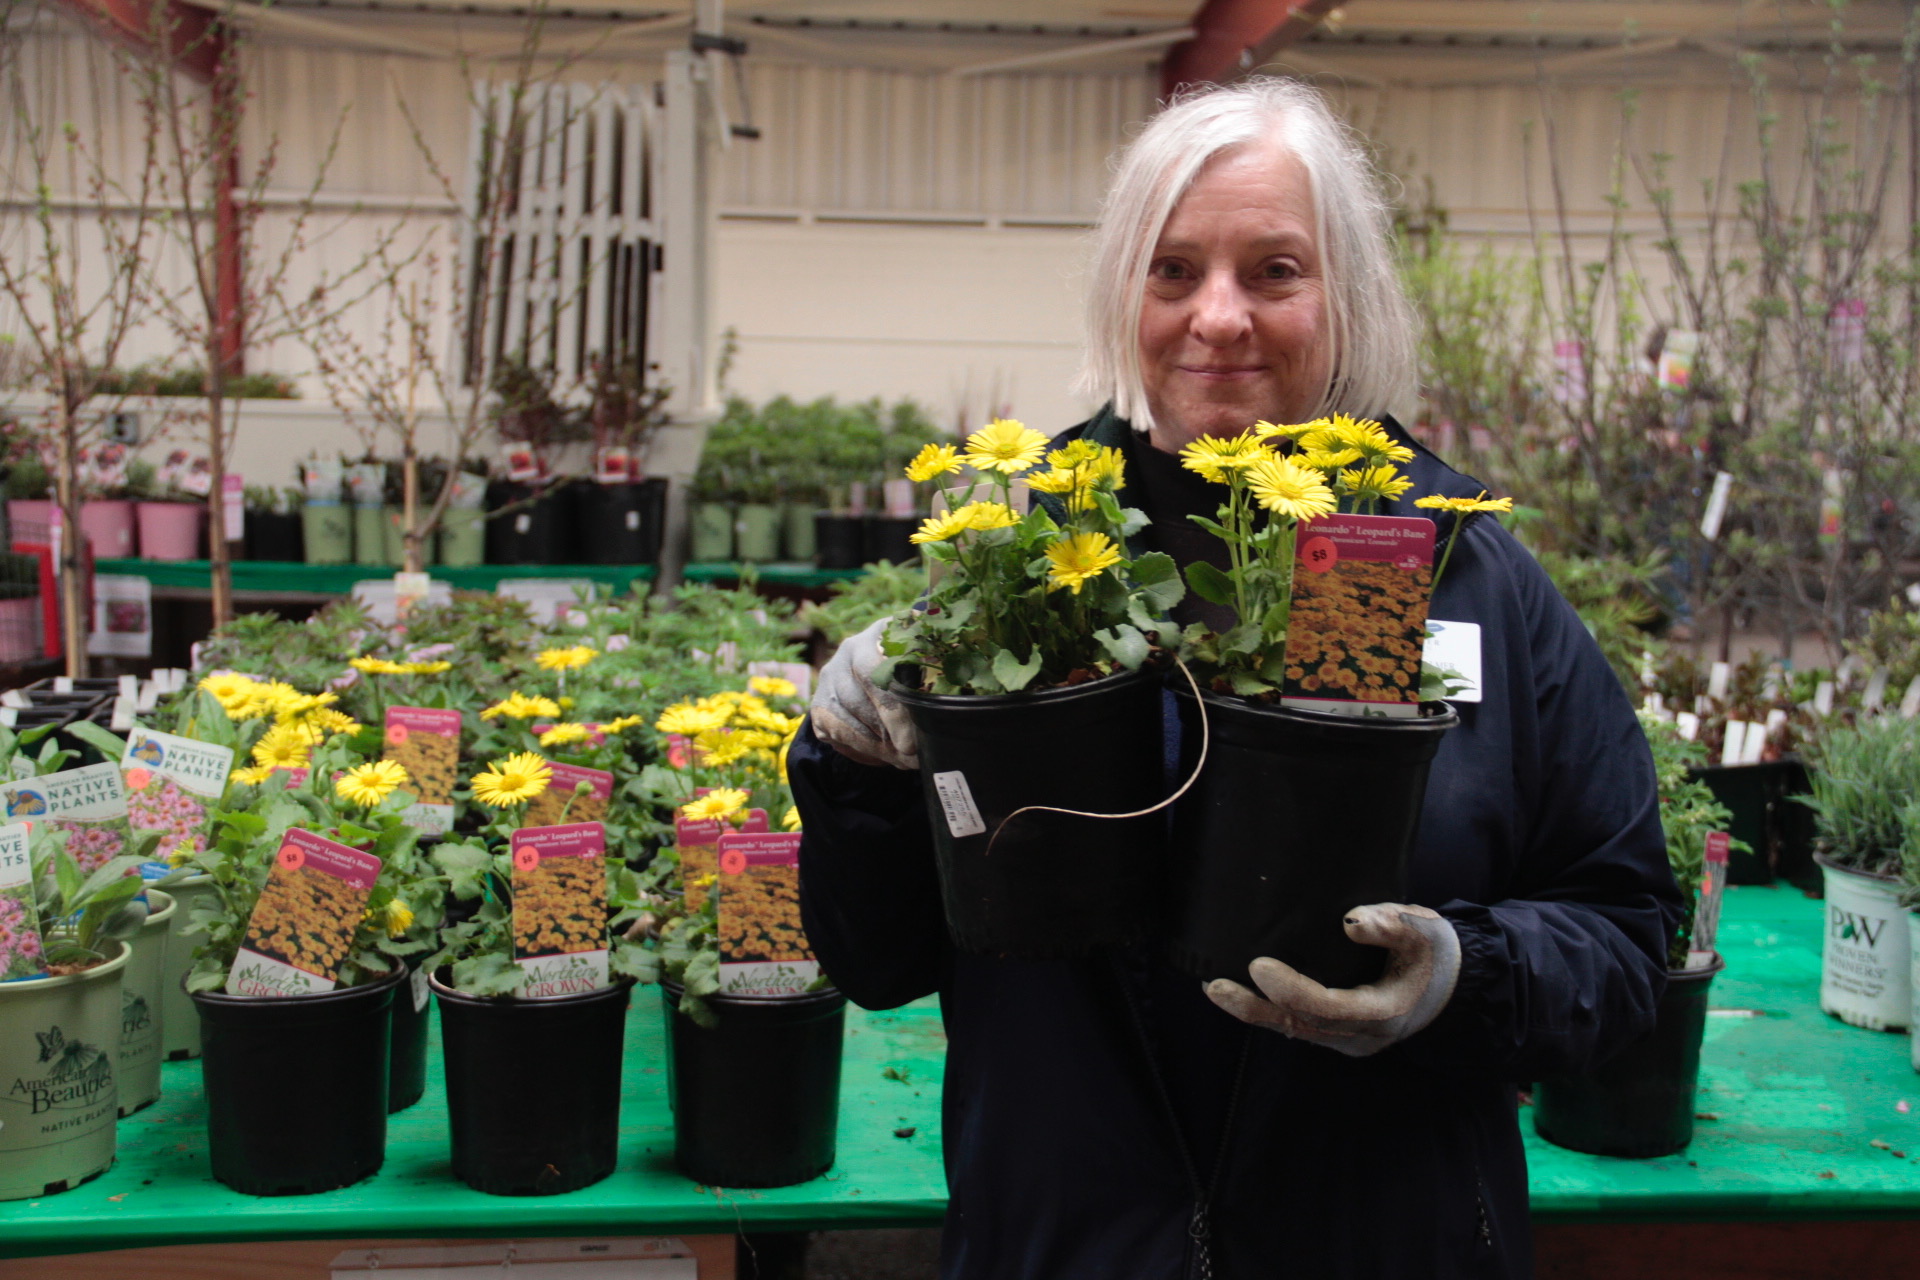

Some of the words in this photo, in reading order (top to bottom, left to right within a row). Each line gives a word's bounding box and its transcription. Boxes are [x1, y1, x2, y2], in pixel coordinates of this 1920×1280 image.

[1356, 527, 1401, 538] Leopard's
[1403, 528, 1427, 539] Bane
[1312, 549, 1327, 562] $8
[167, 749, 226, 770] NATIVE
[164, 760, 223, 781] PLANTS
[47, 777, 117, 800] NATIVE
[286, 854, 297, 863] $8
[526, 977, 596, 999] GROWN
[10, 1069, 88, 1095] American
[41, 1116, 82, 1134] NATIVE
